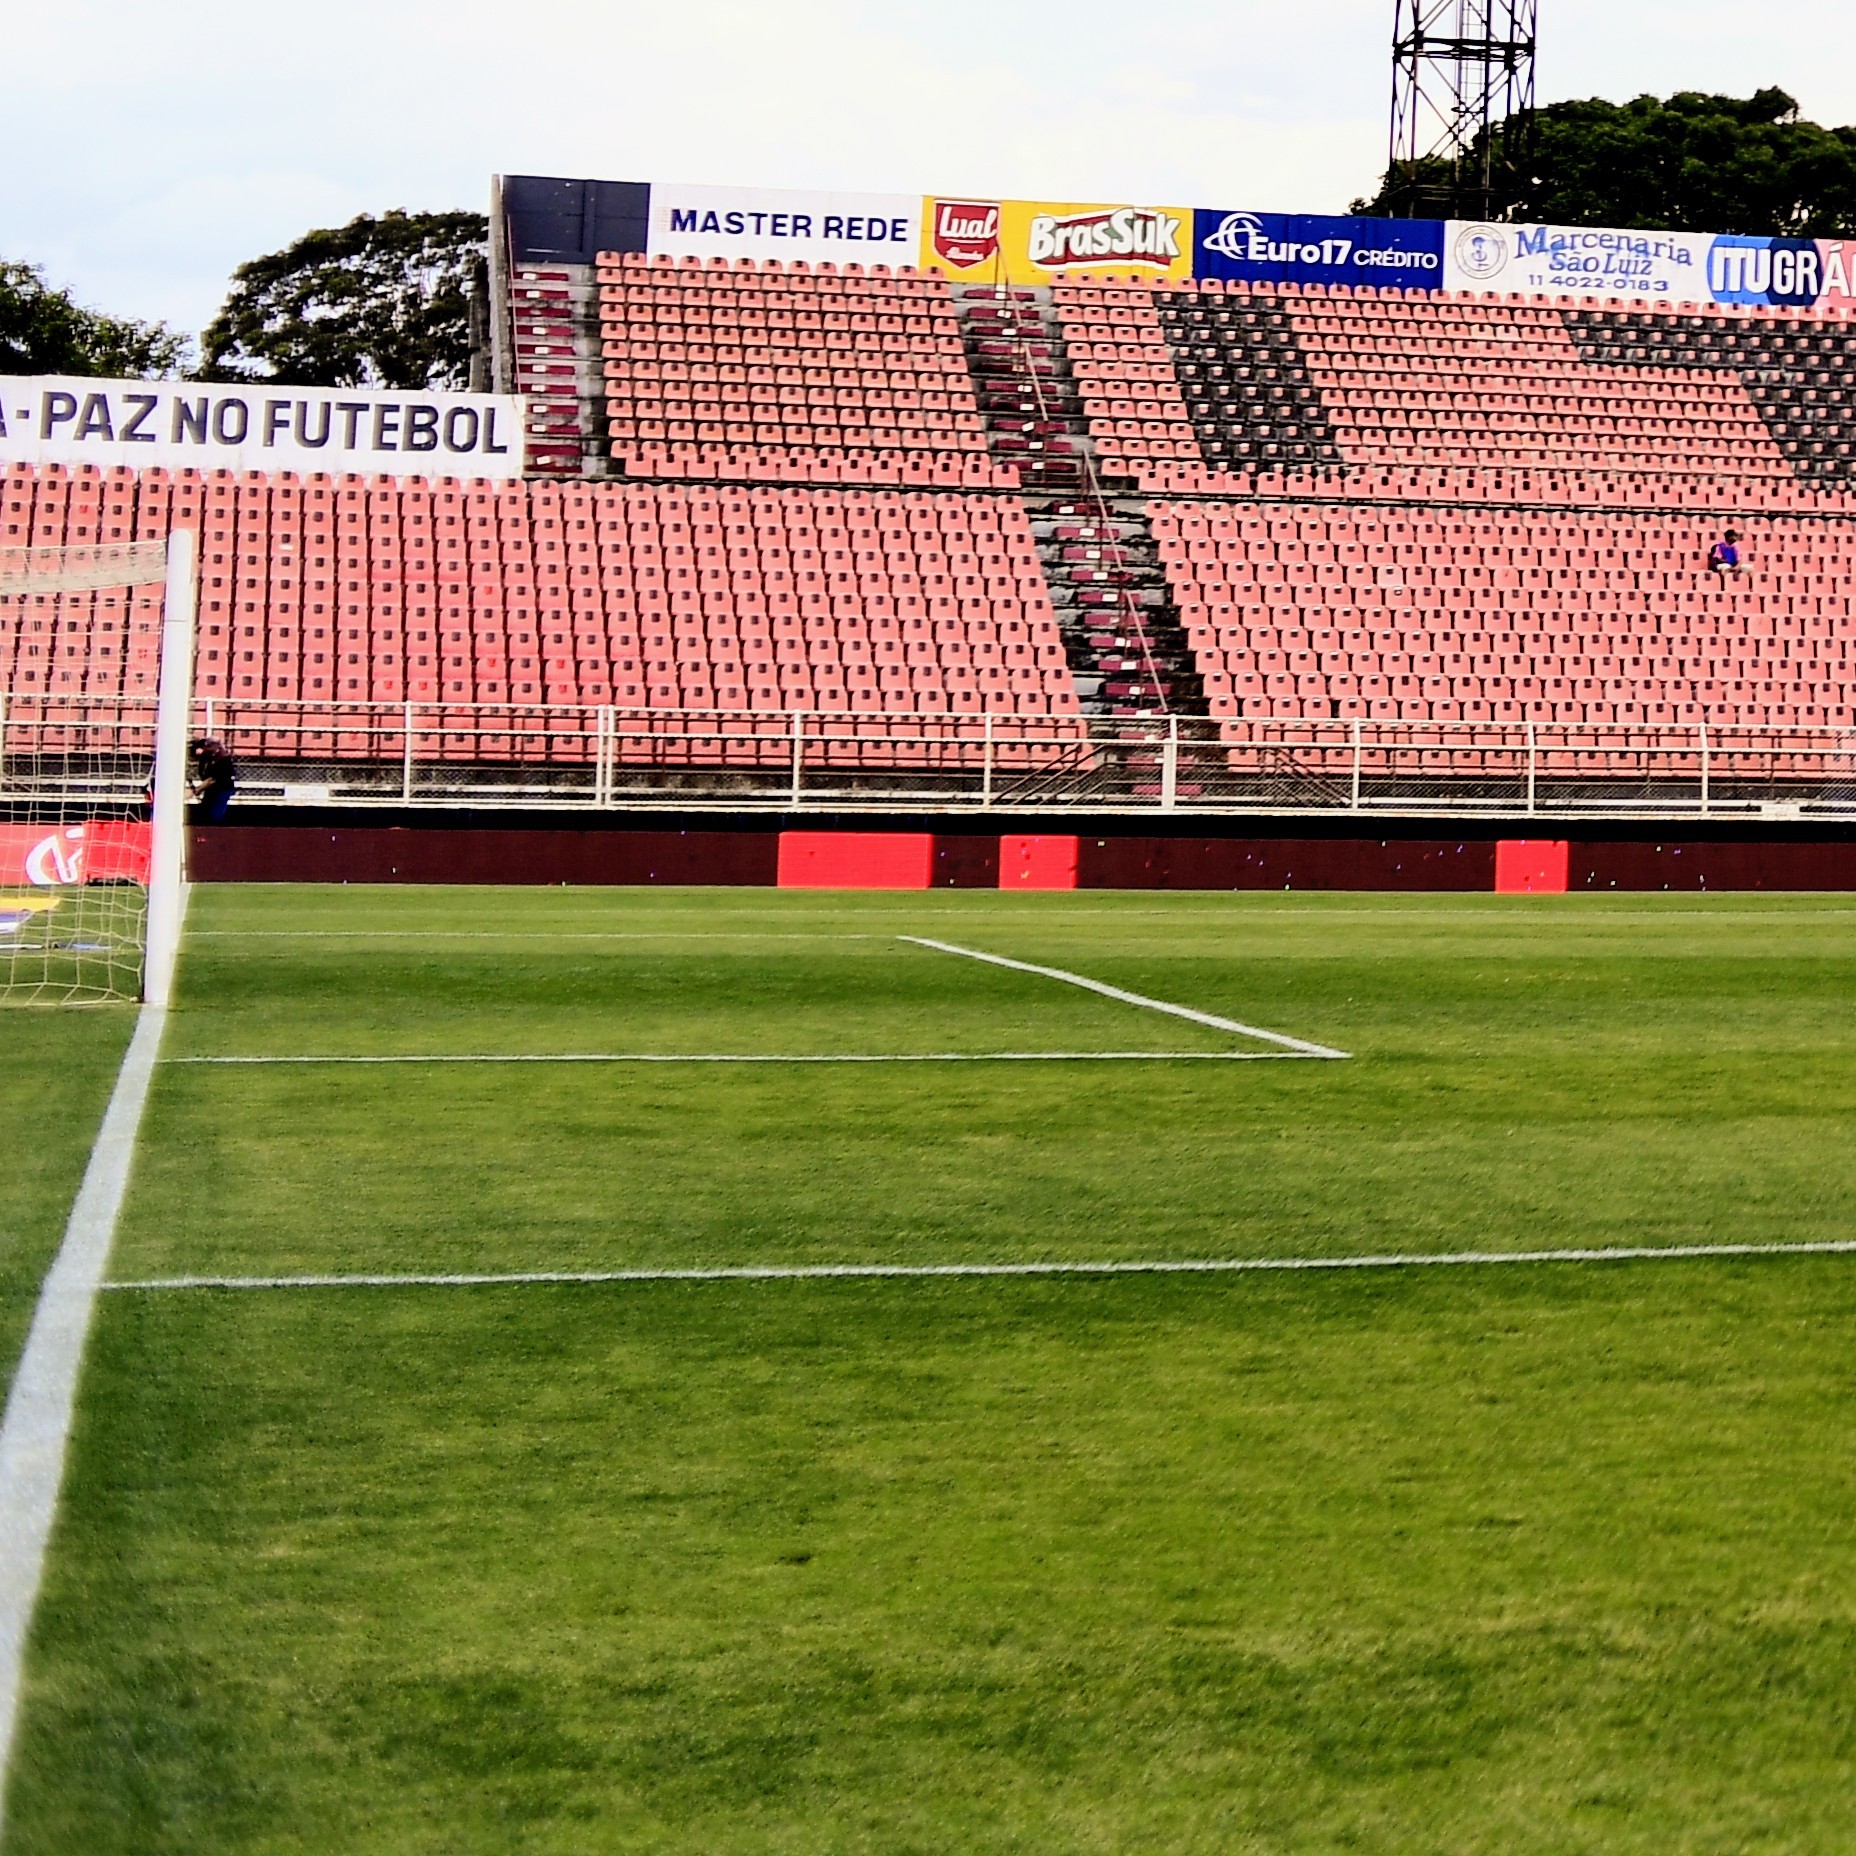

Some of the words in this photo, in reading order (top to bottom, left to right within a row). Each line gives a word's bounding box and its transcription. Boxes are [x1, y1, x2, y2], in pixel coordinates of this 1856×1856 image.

[671, 208, 812, 239] MASTER
[823, 215, 909, 243] REDE
[939, 205, 998, 239] Lual
[1028, 207, 1181, 262] BrasSuk
[1247, 236, 1353, 265] Euro17
[1353, 246, 1439, 269] CRÉDITO
[1513, 226, 1693, 267] Marcenaria
[1549, 251, 1599, 273] São
[1602, 253, 1653, 276] Luiz
[1528, 274, 1544, 286] 11
[1549, 276, 1670, 292] 4022-0183
[39, 391, 158, 442] PAZ
[170, 395, 249, 445] NO
[262, 399, 508, 454] FUTEBOL
